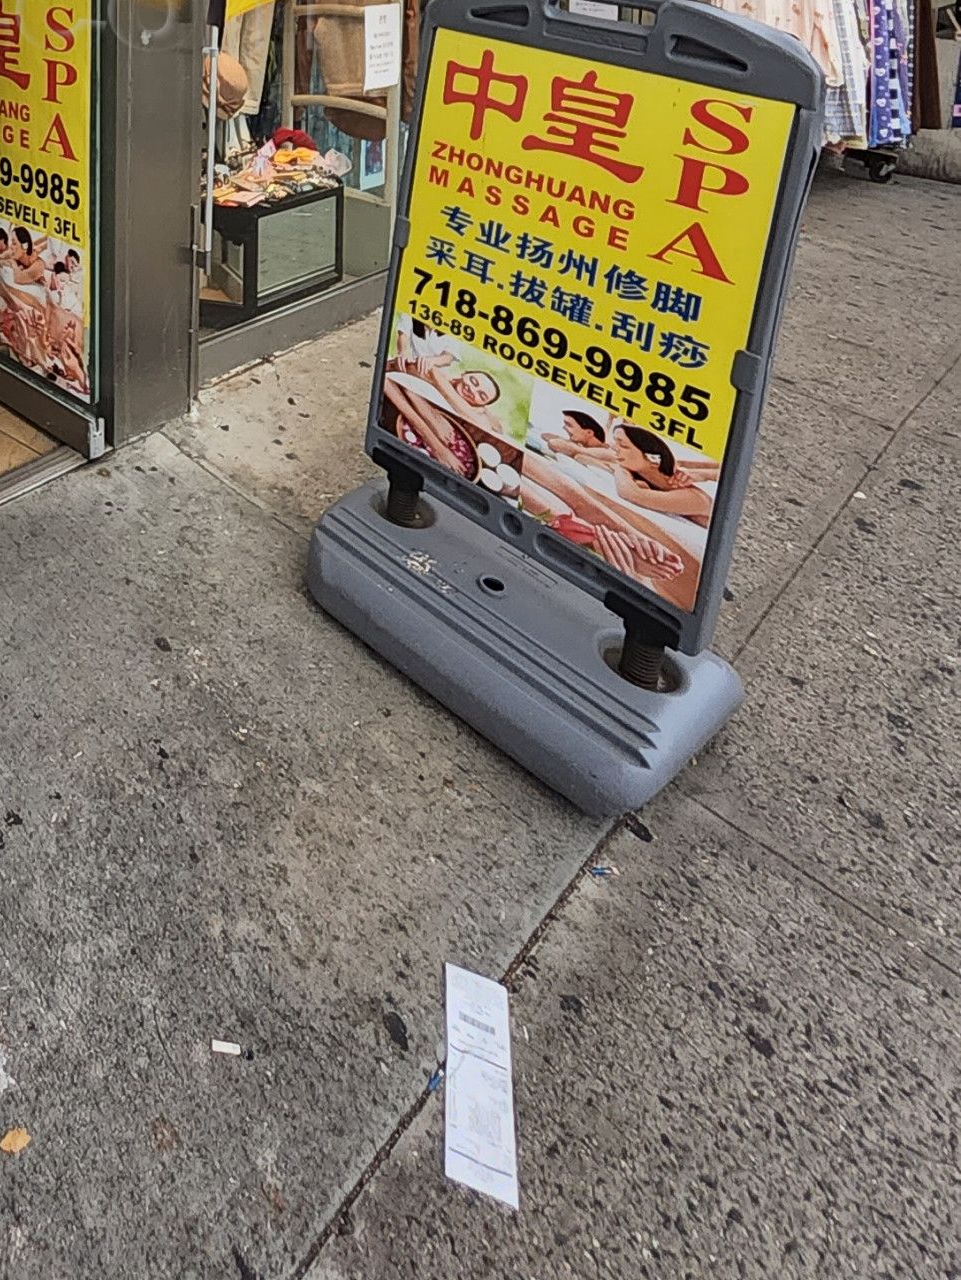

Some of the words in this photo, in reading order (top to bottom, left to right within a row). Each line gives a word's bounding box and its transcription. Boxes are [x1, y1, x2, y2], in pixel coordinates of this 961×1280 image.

[38, 5, 80, 163] SPA
[442, 48, 646, 184] 中皇
[53, 215, 81, 242] 3FL
[428, 163, 631, 253] MASSAGE
[430, 140, 637, 222] ZHONGHUANG
[646, 98, 755, 287] SPA
[440, 203, 704, 325] 专业扬州修脚
[407, 299, 476, 344] 136-89
[482, 330, 642, 419] ROOSEVELT
[649, 410, 705, 451] 3FL
[412, 266, 713, 424] 718-869-9985
